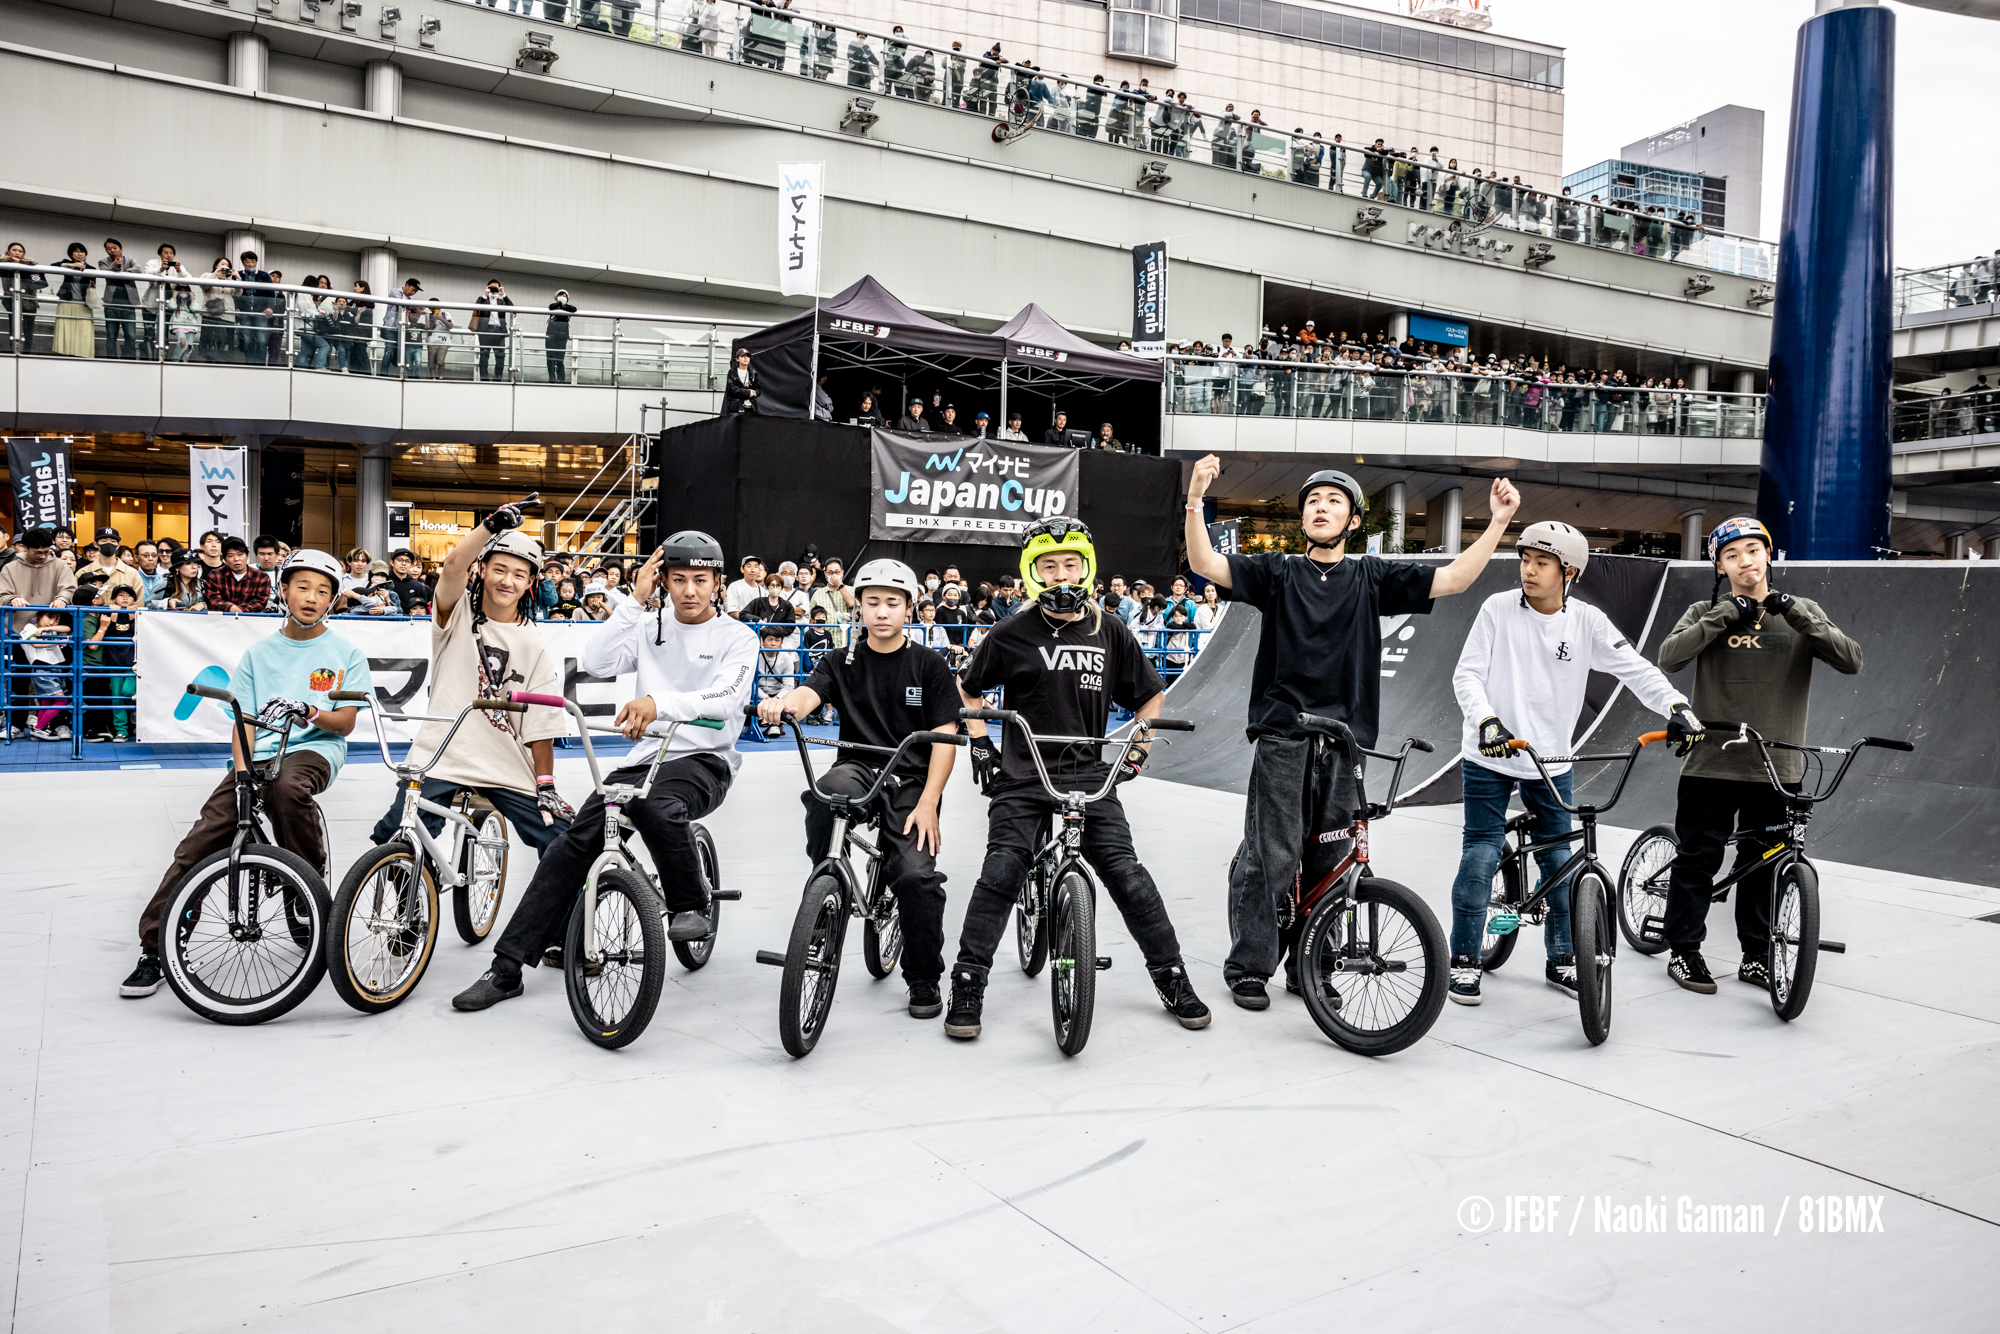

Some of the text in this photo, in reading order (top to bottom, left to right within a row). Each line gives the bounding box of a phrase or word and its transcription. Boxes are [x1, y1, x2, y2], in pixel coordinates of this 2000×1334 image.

[830, 319, 874, 332] JFBF
[1017, 345, 1054, 357] JFBF
[965, 452, 1030, 478] マイナビ
[885, 471, 1066, 518] JapanCup
[420, 519, 459, 534] Honeys
[906, 516, 940, 527] BMX
[1038, 645, 1106, 674] VANS
[1081, 673, 1103, 686] OKB
